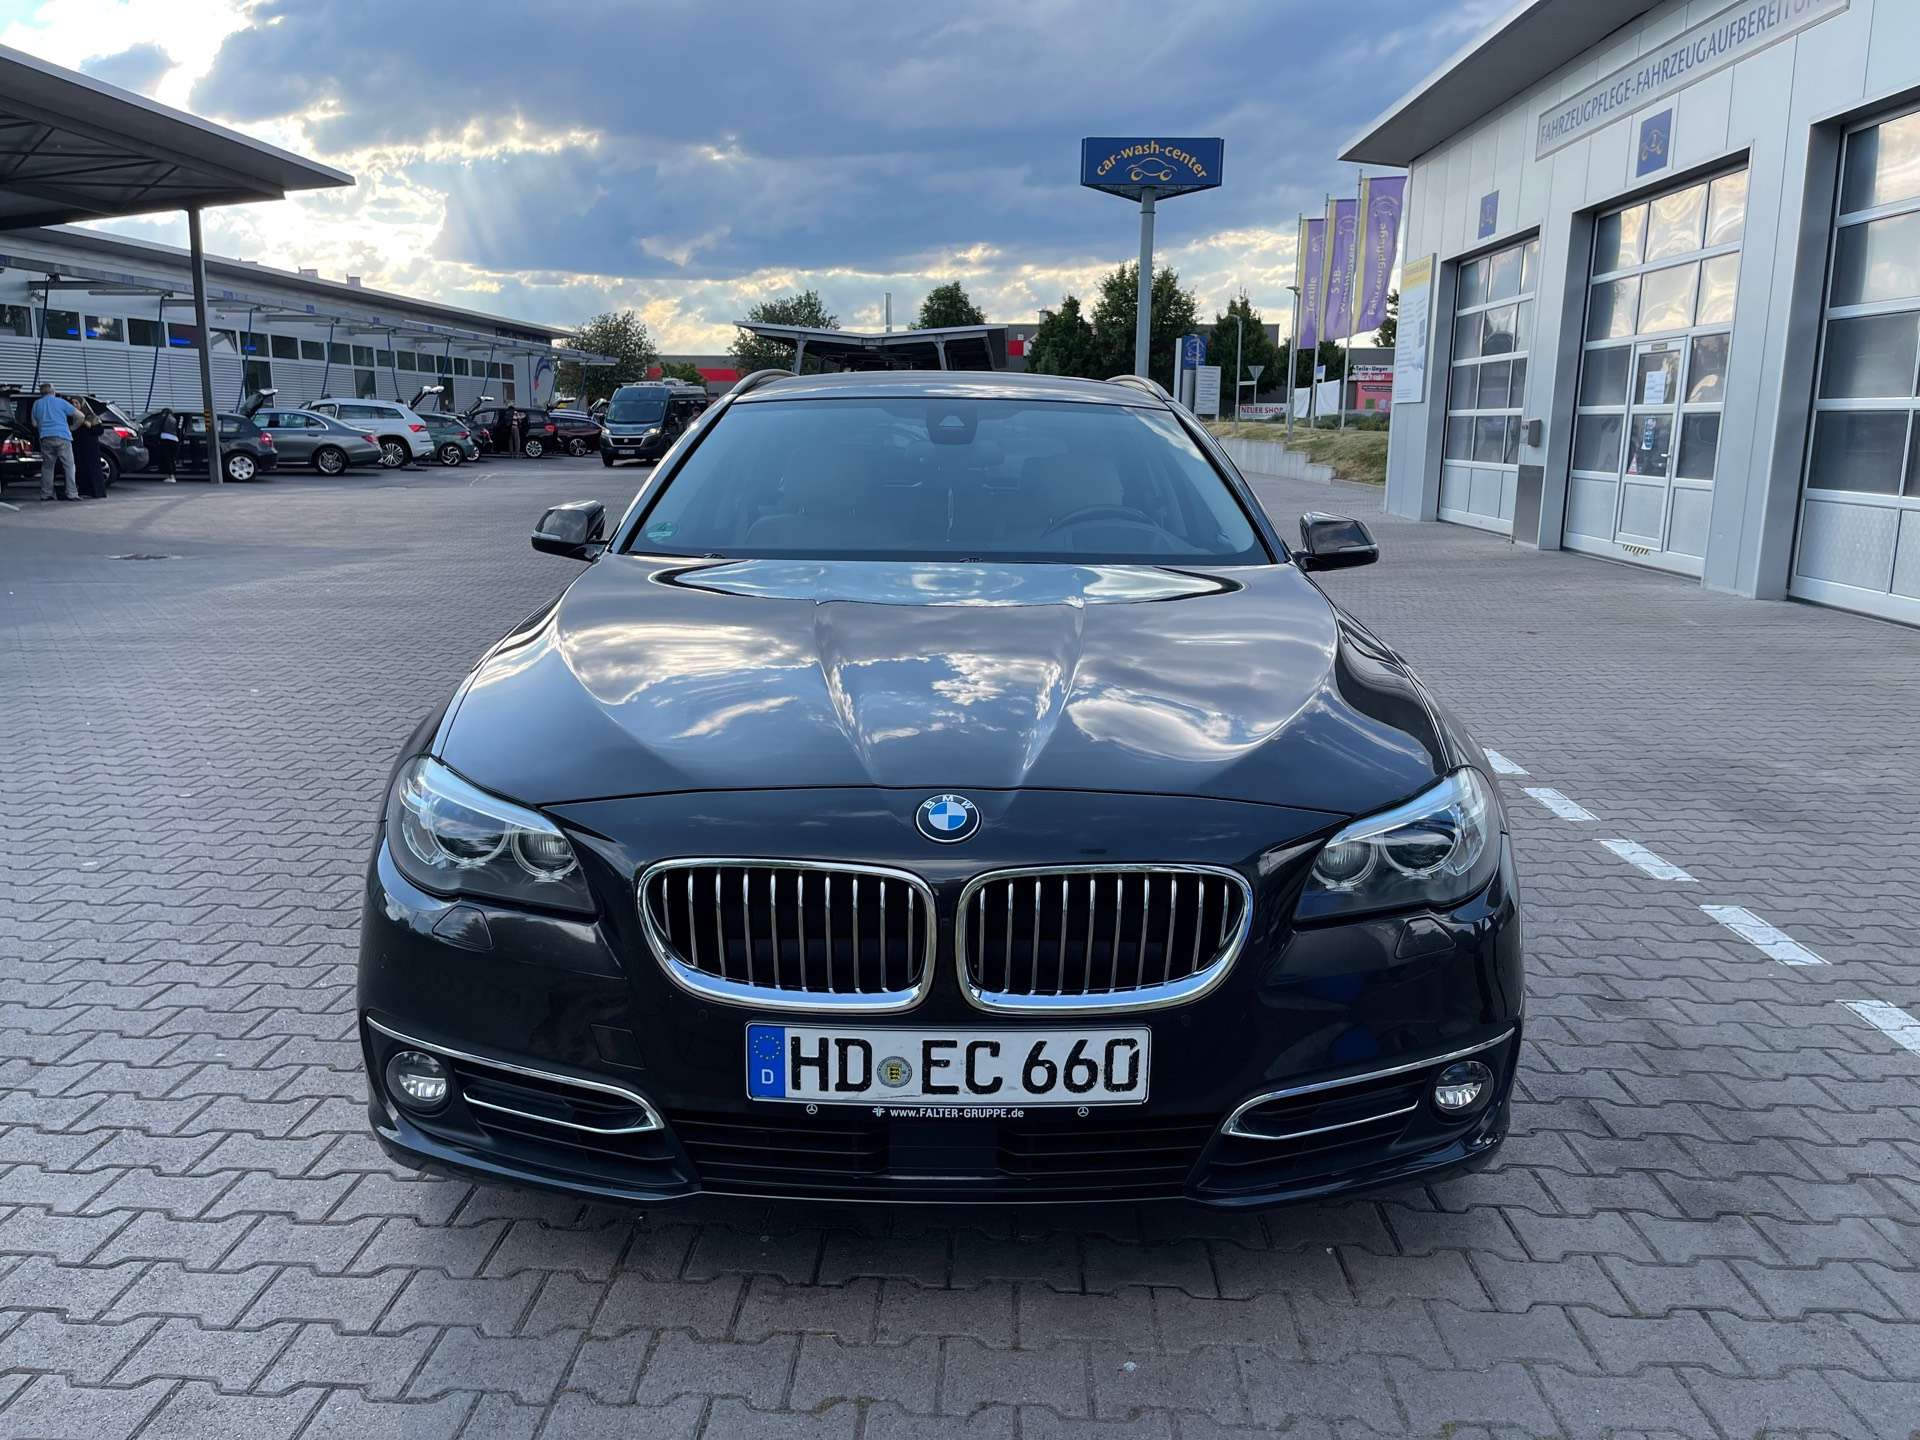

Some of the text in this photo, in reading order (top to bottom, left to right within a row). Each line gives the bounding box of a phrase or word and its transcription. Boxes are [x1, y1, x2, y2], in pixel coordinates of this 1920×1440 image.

[1097, 141, 1207, 178] car-wash-center
[1241, 406, 1263, 414] NEUER
[924, 794, 974, 809] BMW
[790, 1036, 1140, 1095] HD EC 660
[762, 1069, 774, 1085] D
[890, 1108, 1024, 1118] www.FALTER-GRUPPE.de
